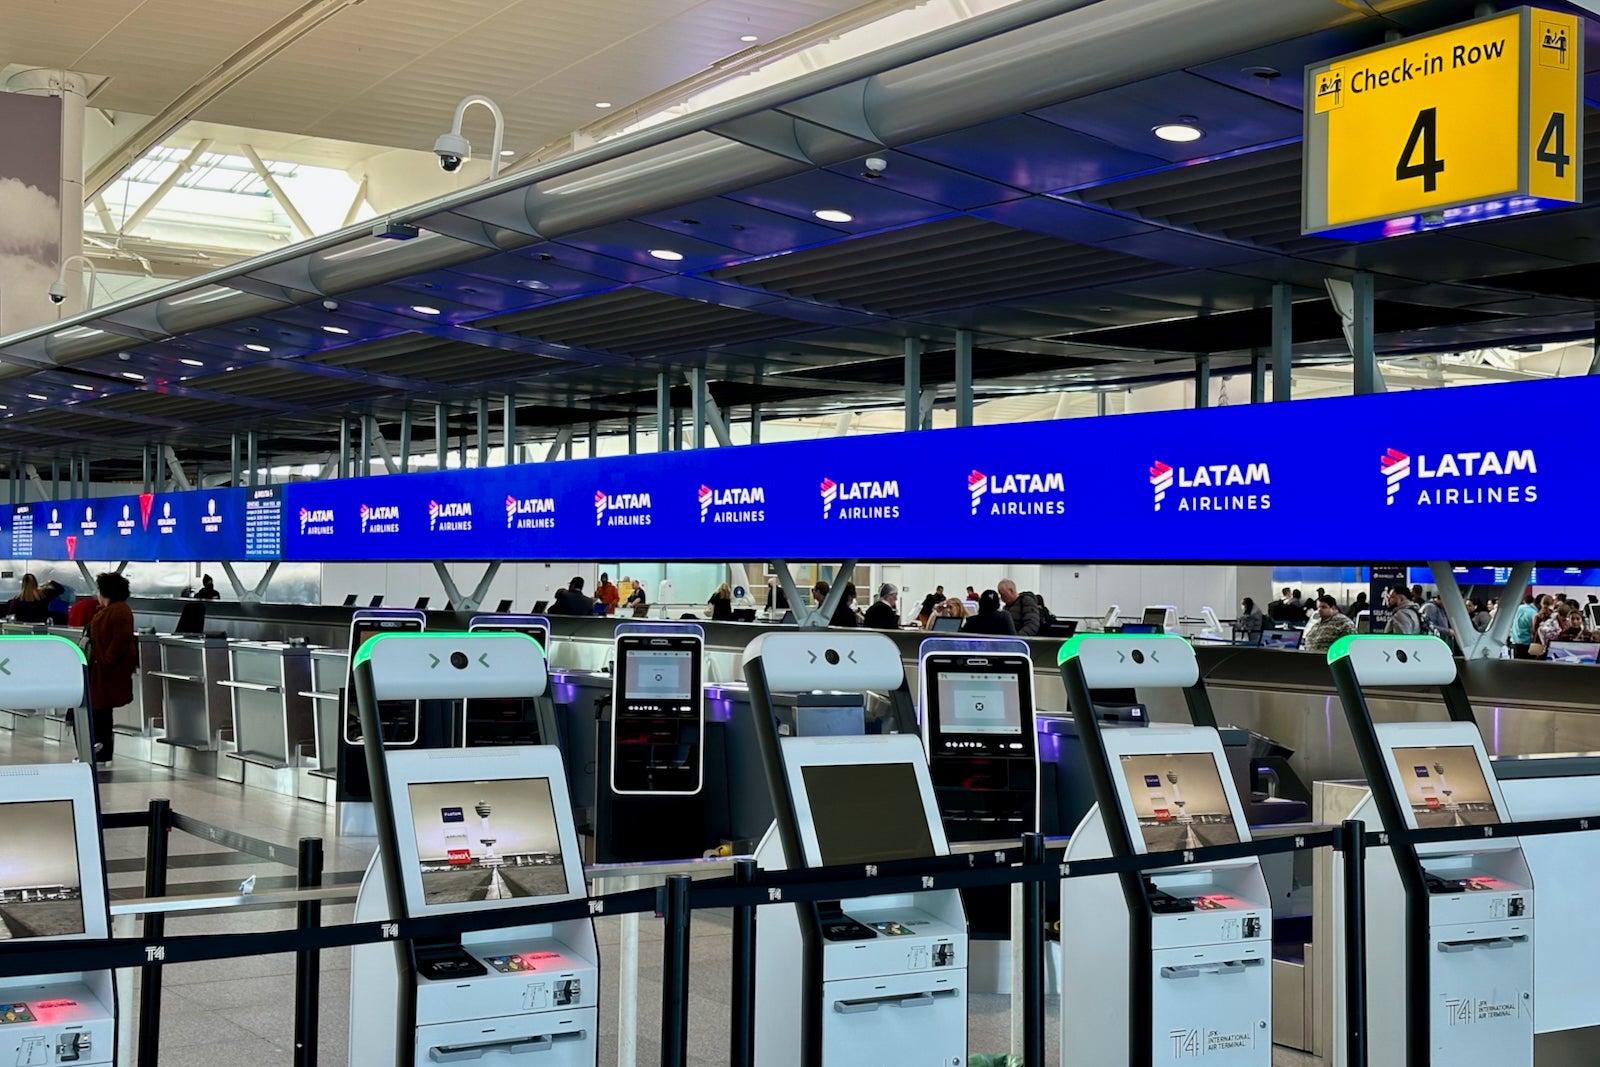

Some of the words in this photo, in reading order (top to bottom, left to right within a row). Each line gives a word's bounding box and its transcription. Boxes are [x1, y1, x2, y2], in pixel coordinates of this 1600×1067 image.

[1351, 52, 1443, 93] Check-in
[1453, 39, 1505, 69] Row
[1396, 107, 1445, 193] 4
[1536, 111, 1570, 178] 4
[1418, 450, 1538, 478] LATAM
[1179, 463, 1270, 487] LATAM
[840, 481, 899, 500] LATAM
[991, 473, 1065, 494] LATAM
[608, 494, 651, 510] LATAM
[714, 487, 764, 506] LATAM
[1179, 495, 1271, 511] AIRLINES
[1418, 486, 1538, 507] AIRLINES
[370, 506, 399, 520] LATAM
[439, 502, 472, 518] LATAM
[517, 498, 555, 513] LATAM
[840, 506, 900, 519] AIRLINES
[991, 501, 1065, 515] AIRLINES
[307, 509, 334, 522] LATAM
[517, 517, 555, 529] AIRLINES
[608, 515, 651, 526] AIRLINES
[714, 510, 765, 523] AIRLINES
[307, 525, 334, 535] AIRLINES
[370, 523, 399, 534] AIRLINES
[439, 520, 472, 531] AIRLINES
[768, 887, 781, 901] T4
[588, 899, 604, 915] T4
[381, 923, 399, 938] T4
[145, 946, 165, 961] T4
[1445, 998, 1471, 1026] T4
[1169, 1029, 1199, 1059] T4
[1208, 1033, 1251, 1044] INTERNATIONAL
[1217, 1040, 1246, 1050] TERMINAL
